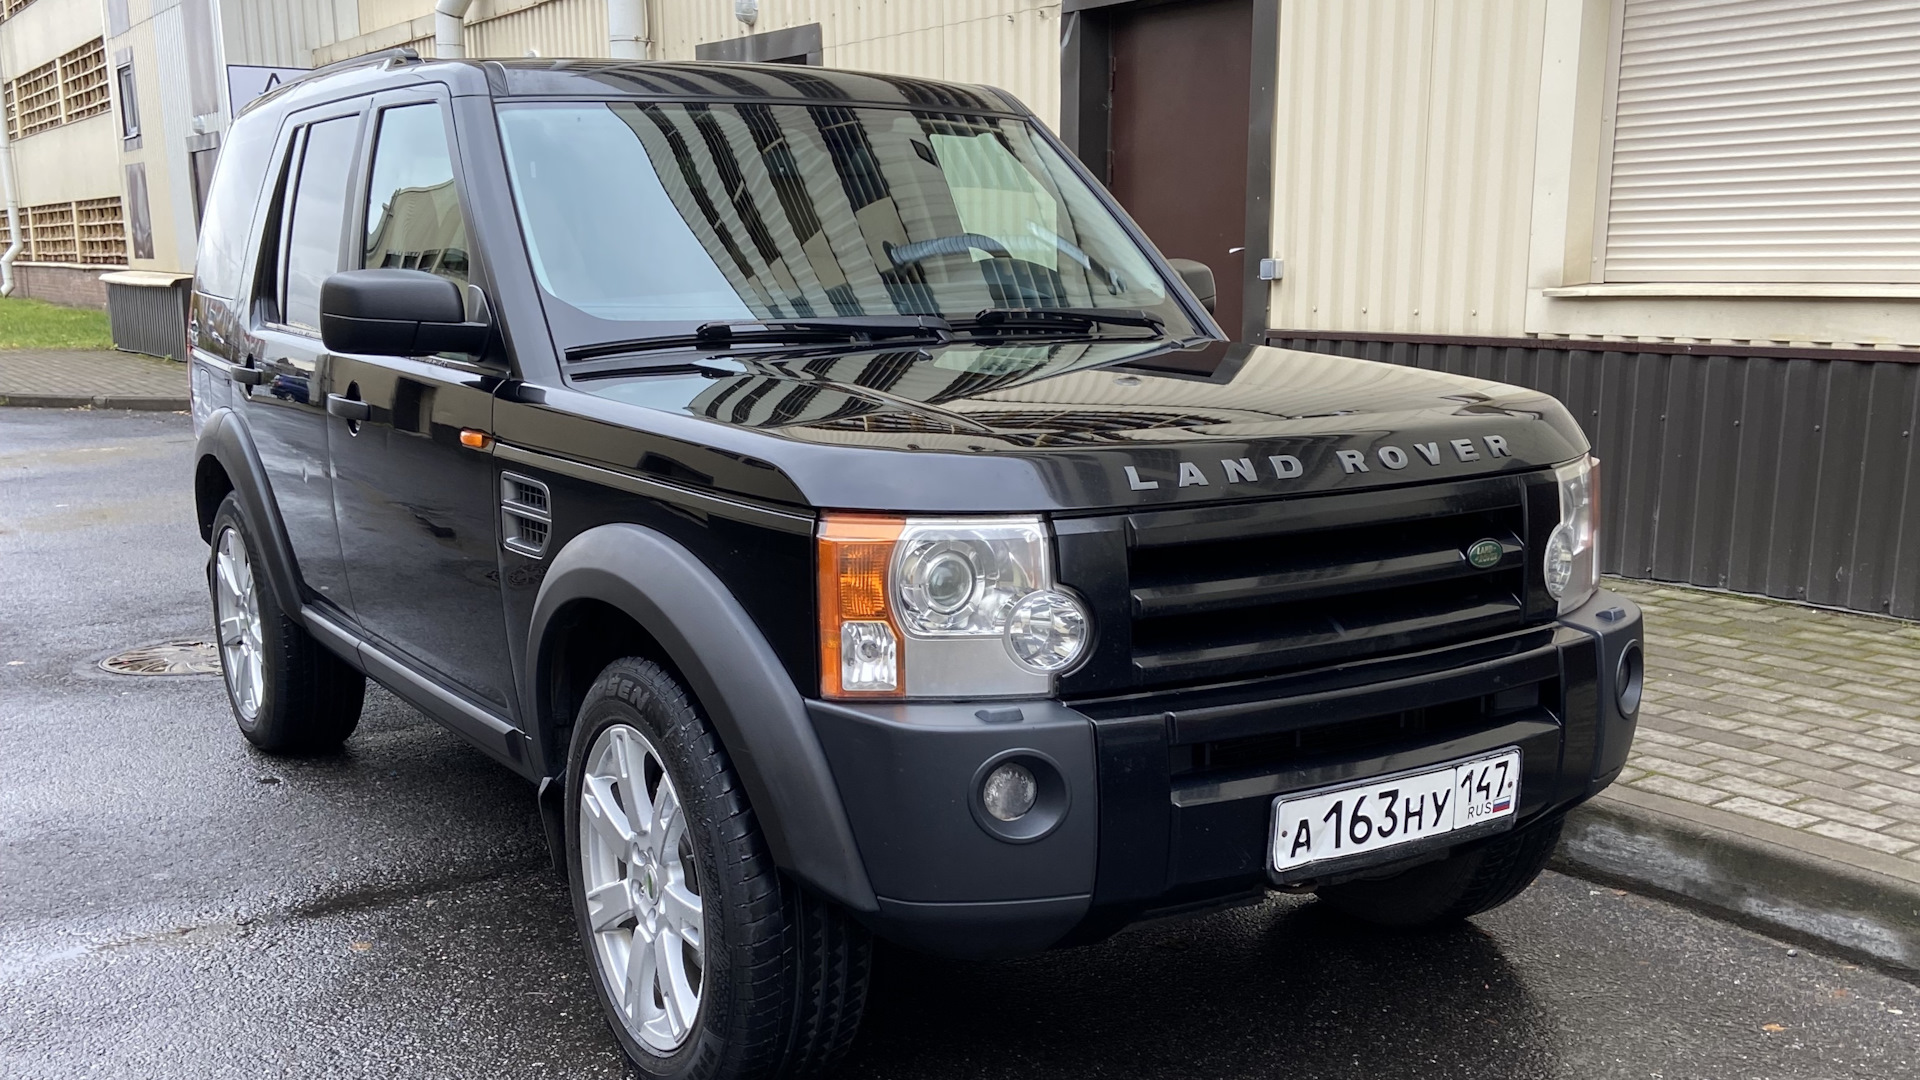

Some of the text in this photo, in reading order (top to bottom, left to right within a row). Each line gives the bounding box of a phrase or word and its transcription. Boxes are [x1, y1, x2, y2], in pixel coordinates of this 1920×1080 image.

[1124, 434, 1512, 491] LAND ROVER
[1460, 760, 1509, 803] 147
[1467, 802, 1492, 819] RUS
